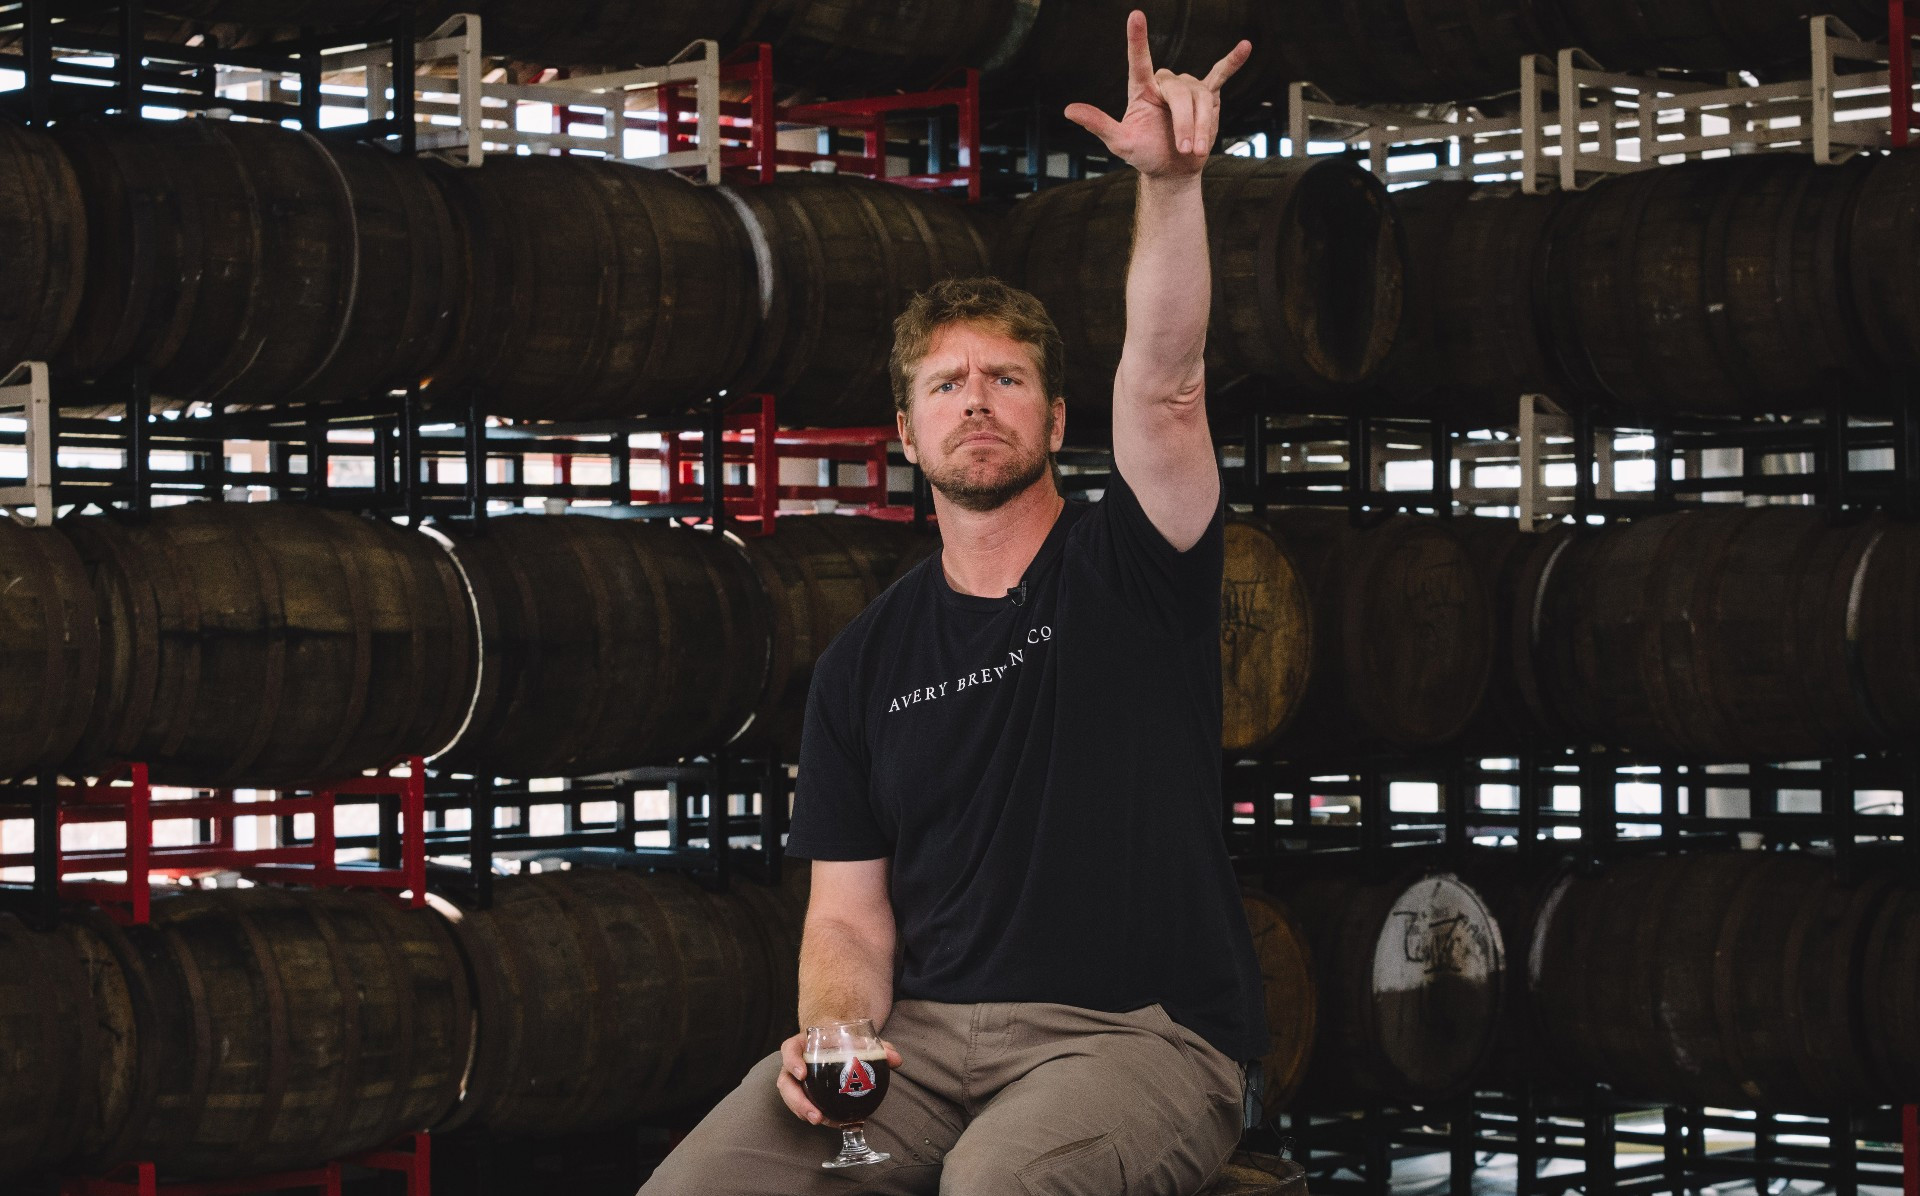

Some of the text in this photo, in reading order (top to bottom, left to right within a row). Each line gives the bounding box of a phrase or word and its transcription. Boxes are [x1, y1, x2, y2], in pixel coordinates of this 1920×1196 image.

[888, 681, 948, 713] AVERY
[956, 649, 1024, 692] BREWN
[839, 1056, 876, 1094] A
